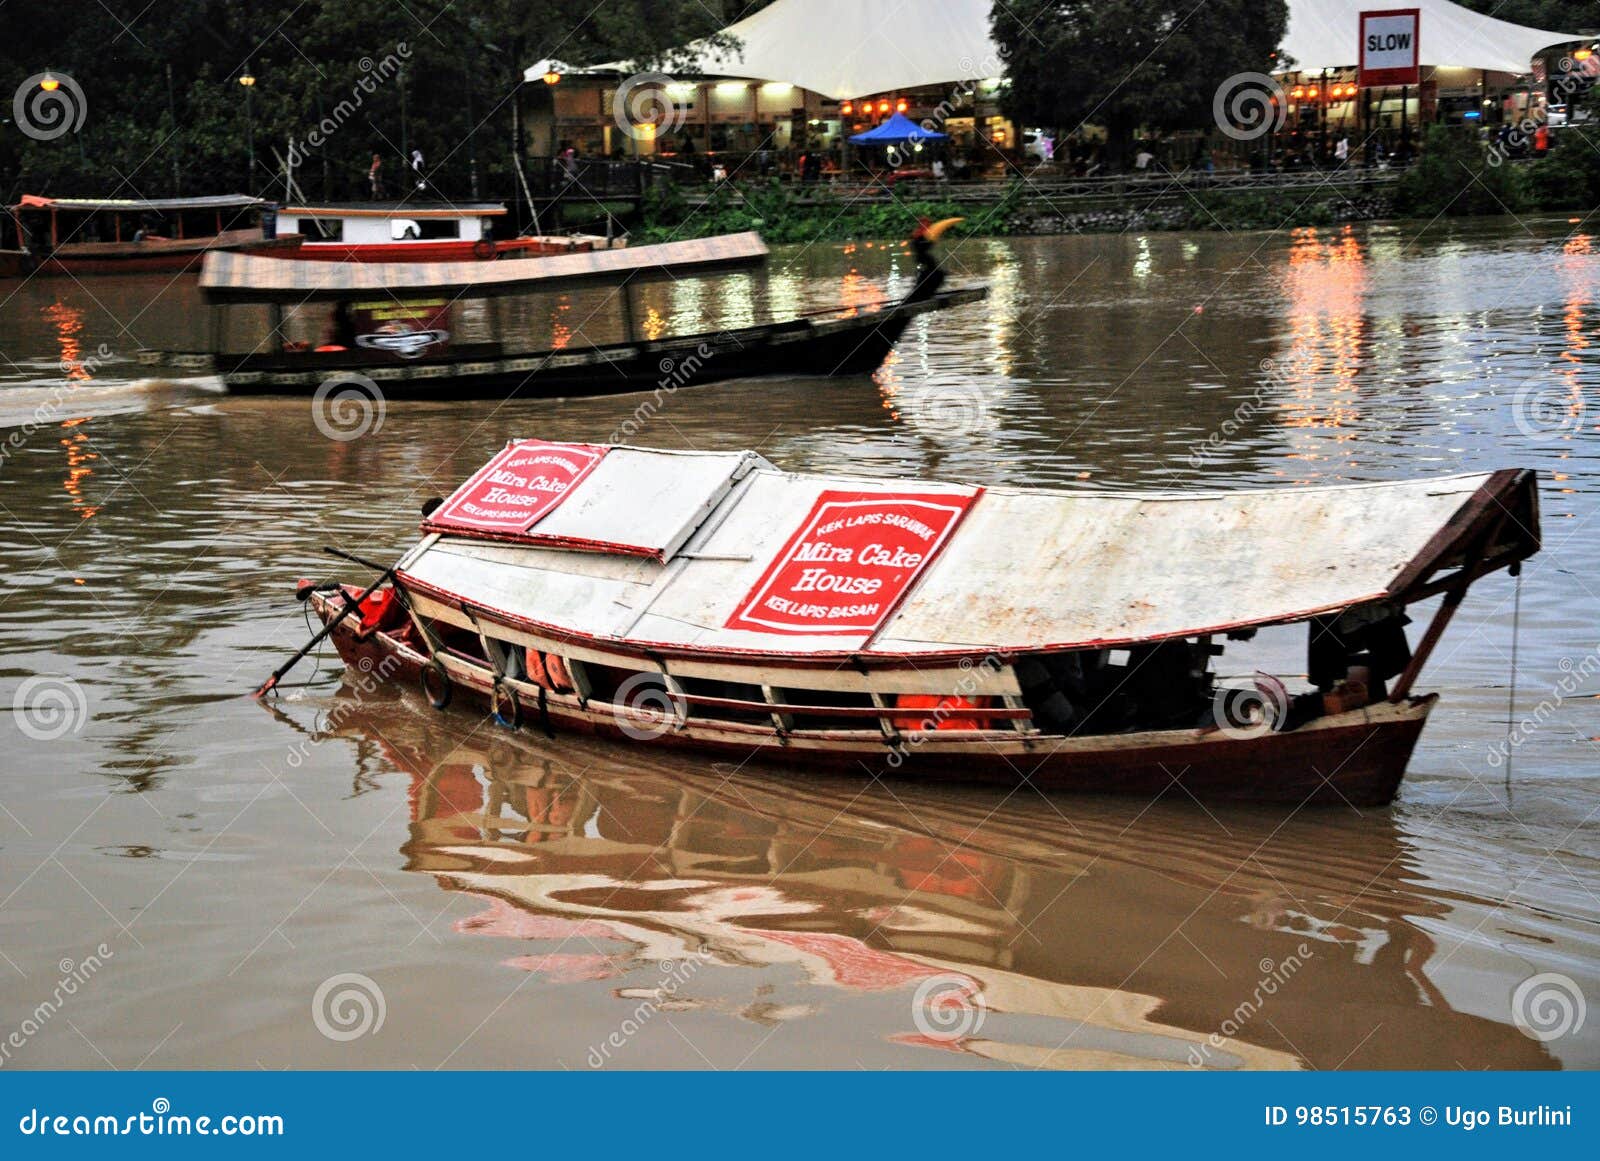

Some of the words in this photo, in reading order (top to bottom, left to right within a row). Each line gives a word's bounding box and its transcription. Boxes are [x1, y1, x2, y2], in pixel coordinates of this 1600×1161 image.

[1367, 33, 1411, 52] SLOW
[507, 457, 527, 468] KEK
[486, 469, 527, 488] Mira
[528, 475, 568, 493] Cake
[480, 487, 538, 506] House
[816, 518, 845, 537] KEK
[845, 513, 883, 527] LAPIS
[882, 513, 937, 541] SARAWAK
[792, 542, 852, 563] Mira
[858, 543, 923, 568] Cake
[790, 568, 883, 595] House
[763, 595, 790, 613] KEK
[788, 599, 827, 619] LAPIS
[828, 603, 879, 619] BASAH
